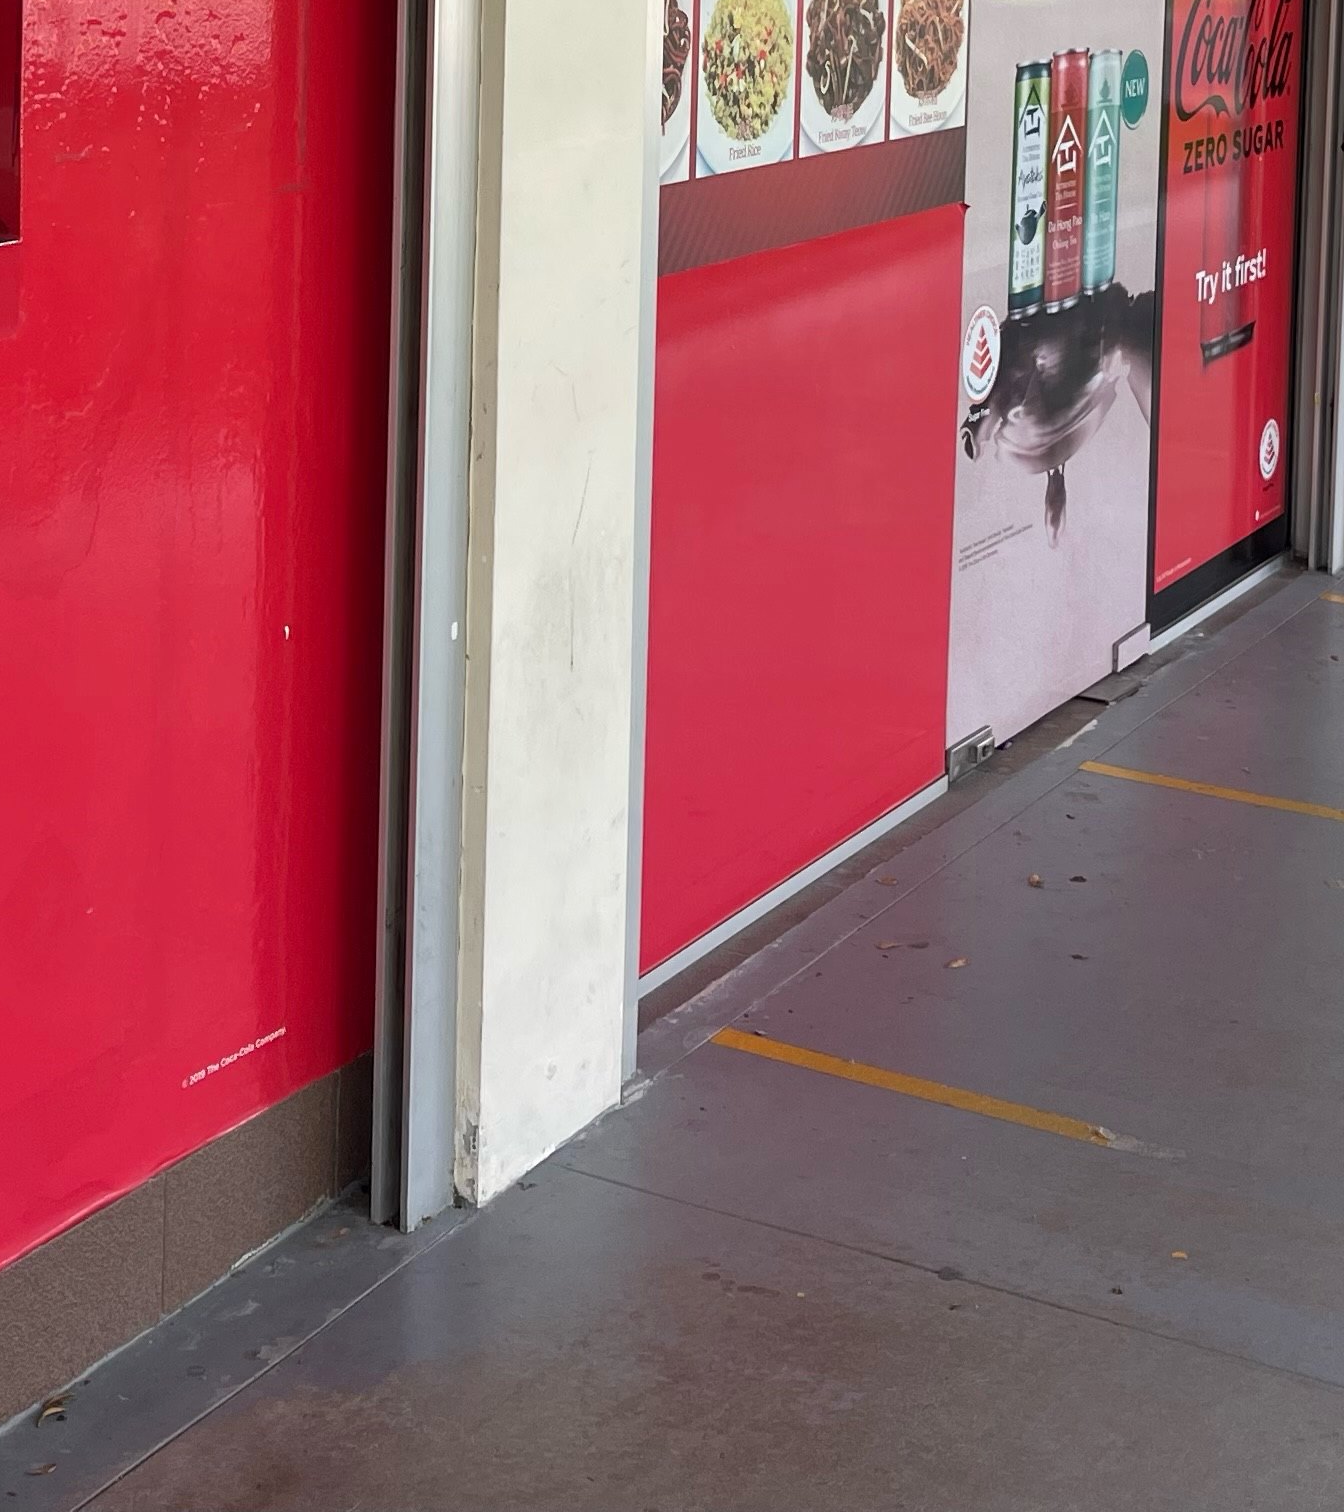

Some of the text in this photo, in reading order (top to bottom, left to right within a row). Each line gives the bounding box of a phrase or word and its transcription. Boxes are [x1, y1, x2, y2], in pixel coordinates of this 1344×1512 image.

[1124, 77, 1146, 99] NEW
[1183, 119, 1284, 175] ZERO SUGAR
[1196, 247, 1267, 305] Try it first!
